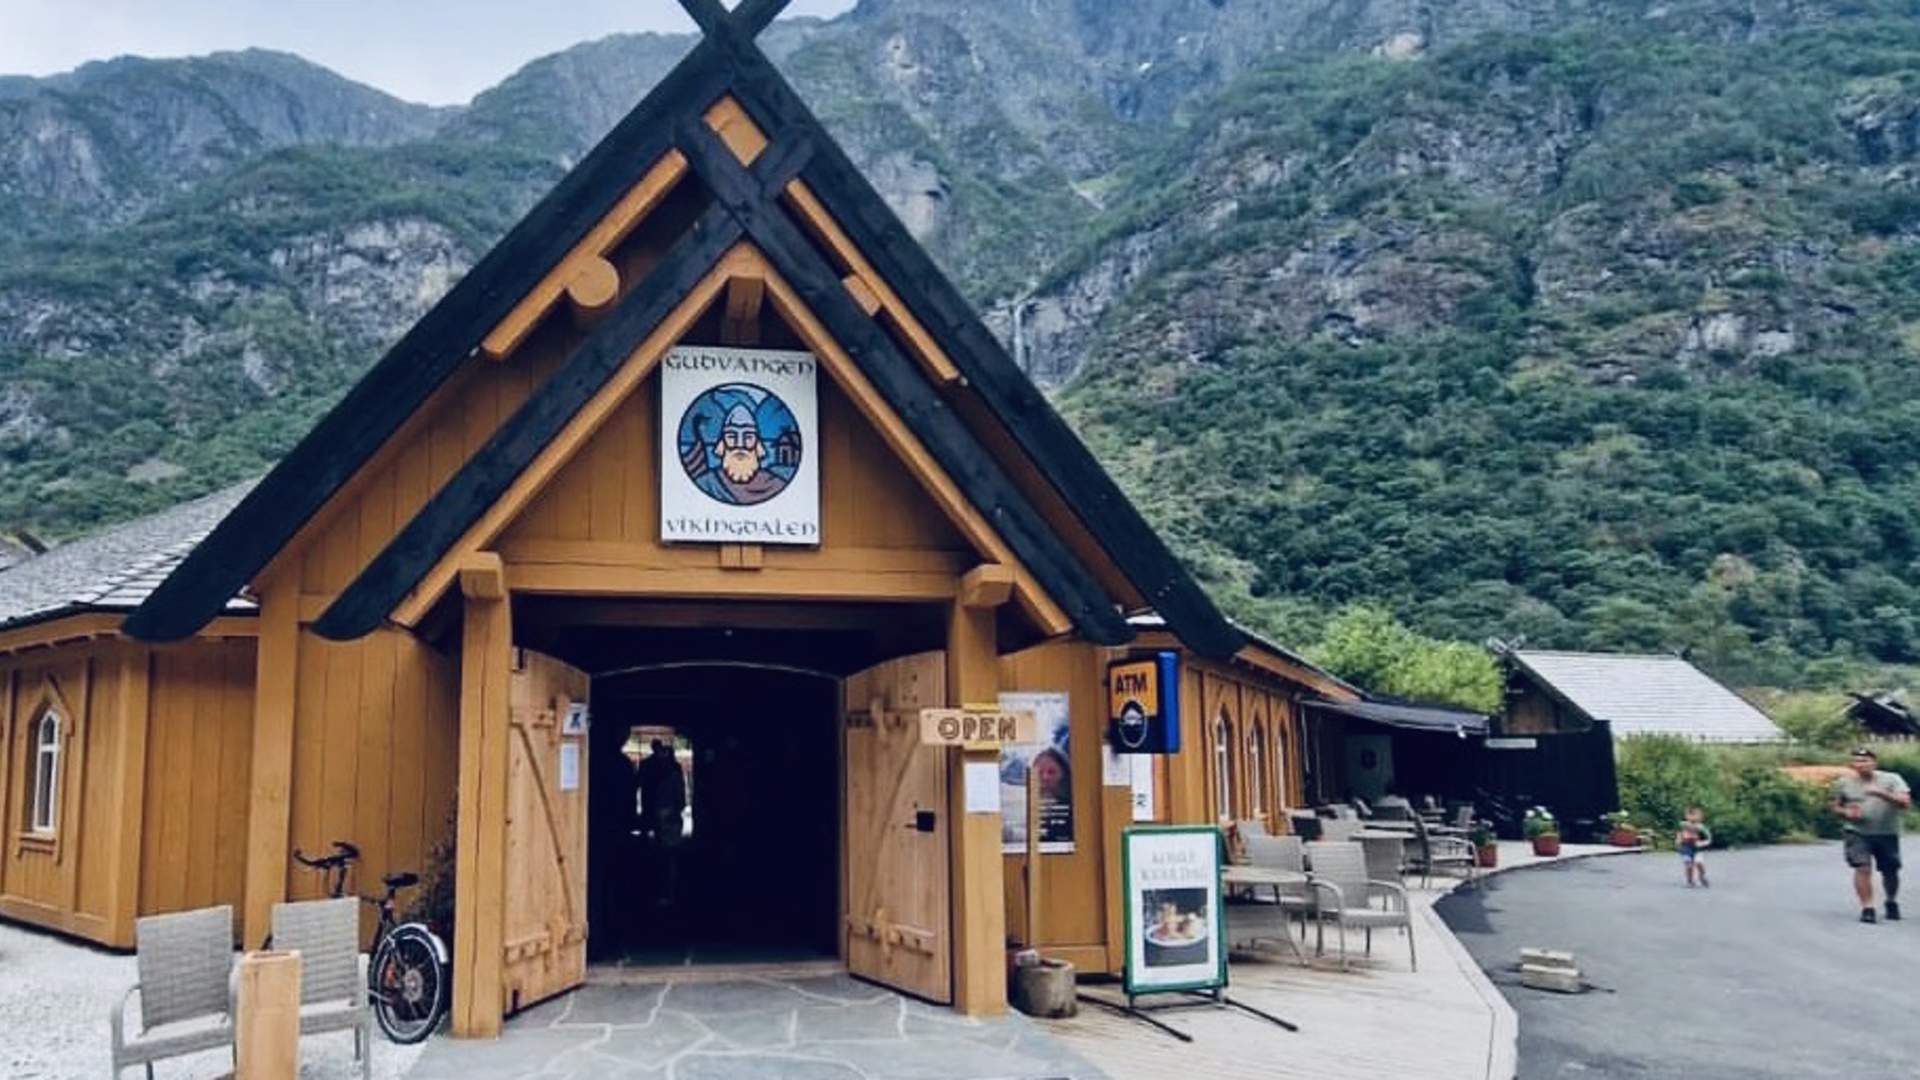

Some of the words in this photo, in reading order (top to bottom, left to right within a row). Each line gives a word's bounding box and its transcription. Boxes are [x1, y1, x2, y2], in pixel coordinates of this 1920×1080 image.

[666, 354, 813, 375] GUDVANGEN
[1115, 672, 1147, 695] ATM
[938, 716, 1016, 740] OPEN
